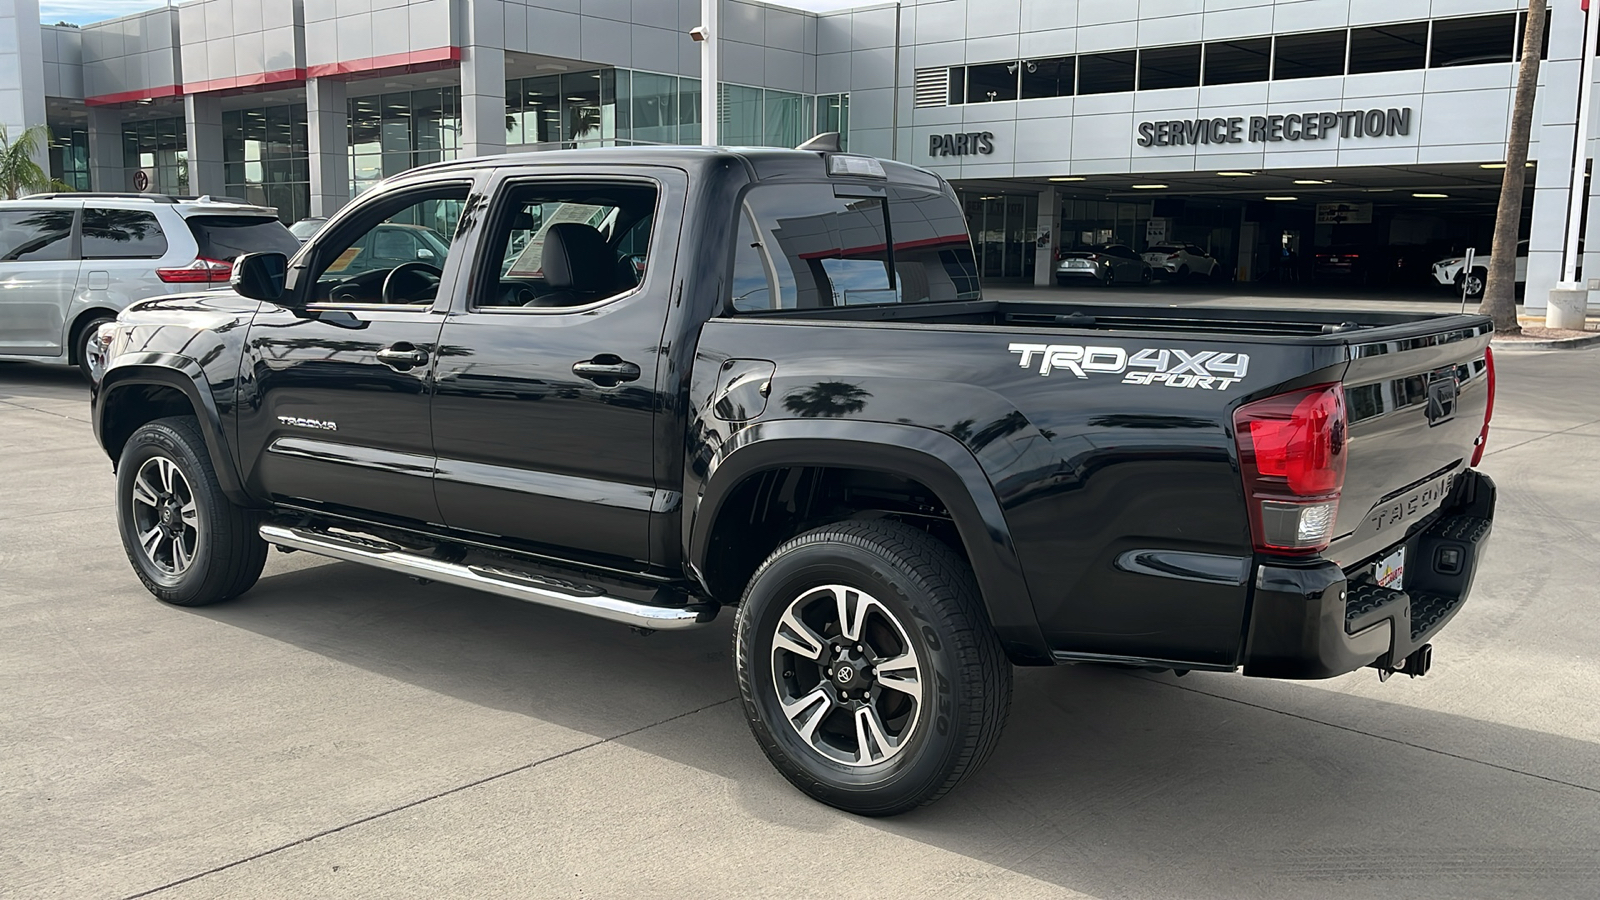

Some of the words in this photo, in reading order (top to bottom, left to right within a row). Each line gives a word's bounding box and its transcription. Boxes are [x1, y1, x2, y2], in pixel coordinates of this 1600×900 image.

[1137, 117, 1243, 147] SERVICE
[1248, 107, 1411, 143] RECEPTION
[929, 131, 994, 156] PARTS
[1008, 343, 1128, 380] TRD
[1121, 371, 1242, 391] SPORT
[277, 416, 337, 431] TACOMA
[1371, 473, 1454, 531] TACOMA
